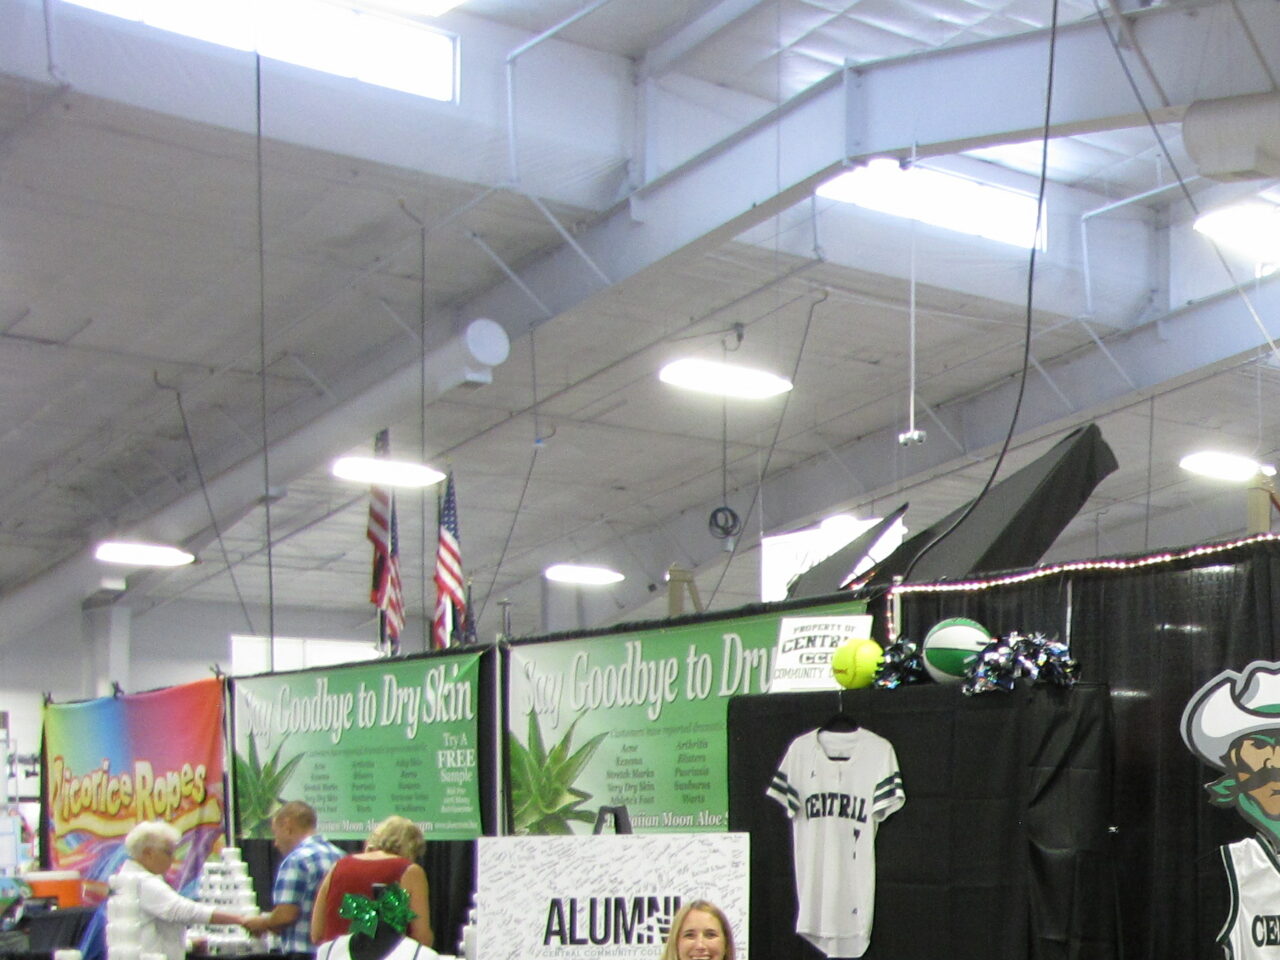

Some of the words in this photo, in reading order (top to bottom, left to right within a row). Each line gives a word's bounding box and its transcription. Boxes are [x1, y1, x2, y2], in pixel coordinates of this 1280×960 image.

[793, 623, 842, 634] PROPERTY
[844, 625, 857, 633] OF
[781, 634, 849, 654] CENTR
[799, 652, 834, 664] CC
[570, 641, 679, 721] Goodbye
[685, 644, 712, 700] to
[719, 632, 778, 698] Dry
[774, 667, 824, 680] COMMUNITY
[279, 676, 353, 745] Goodbye
[358, 682, 377, 729] to
[381, 674, 421, 740] Dry
[422, 664, 475, 724] Skin
[443, 733, 458, 749] Try
[461, 733, 468, 746] A
[437, 749, 476, 769] FREE
[440, 768, 473, 785] Sample
[51, 754, 134, 824] Licorice
[133, 759, 207, 823] Ropes
[661, 811, 694, 827] Moon
[696, 810, 722, 826] Aloe
[640, 948, 663, 957] COLL
